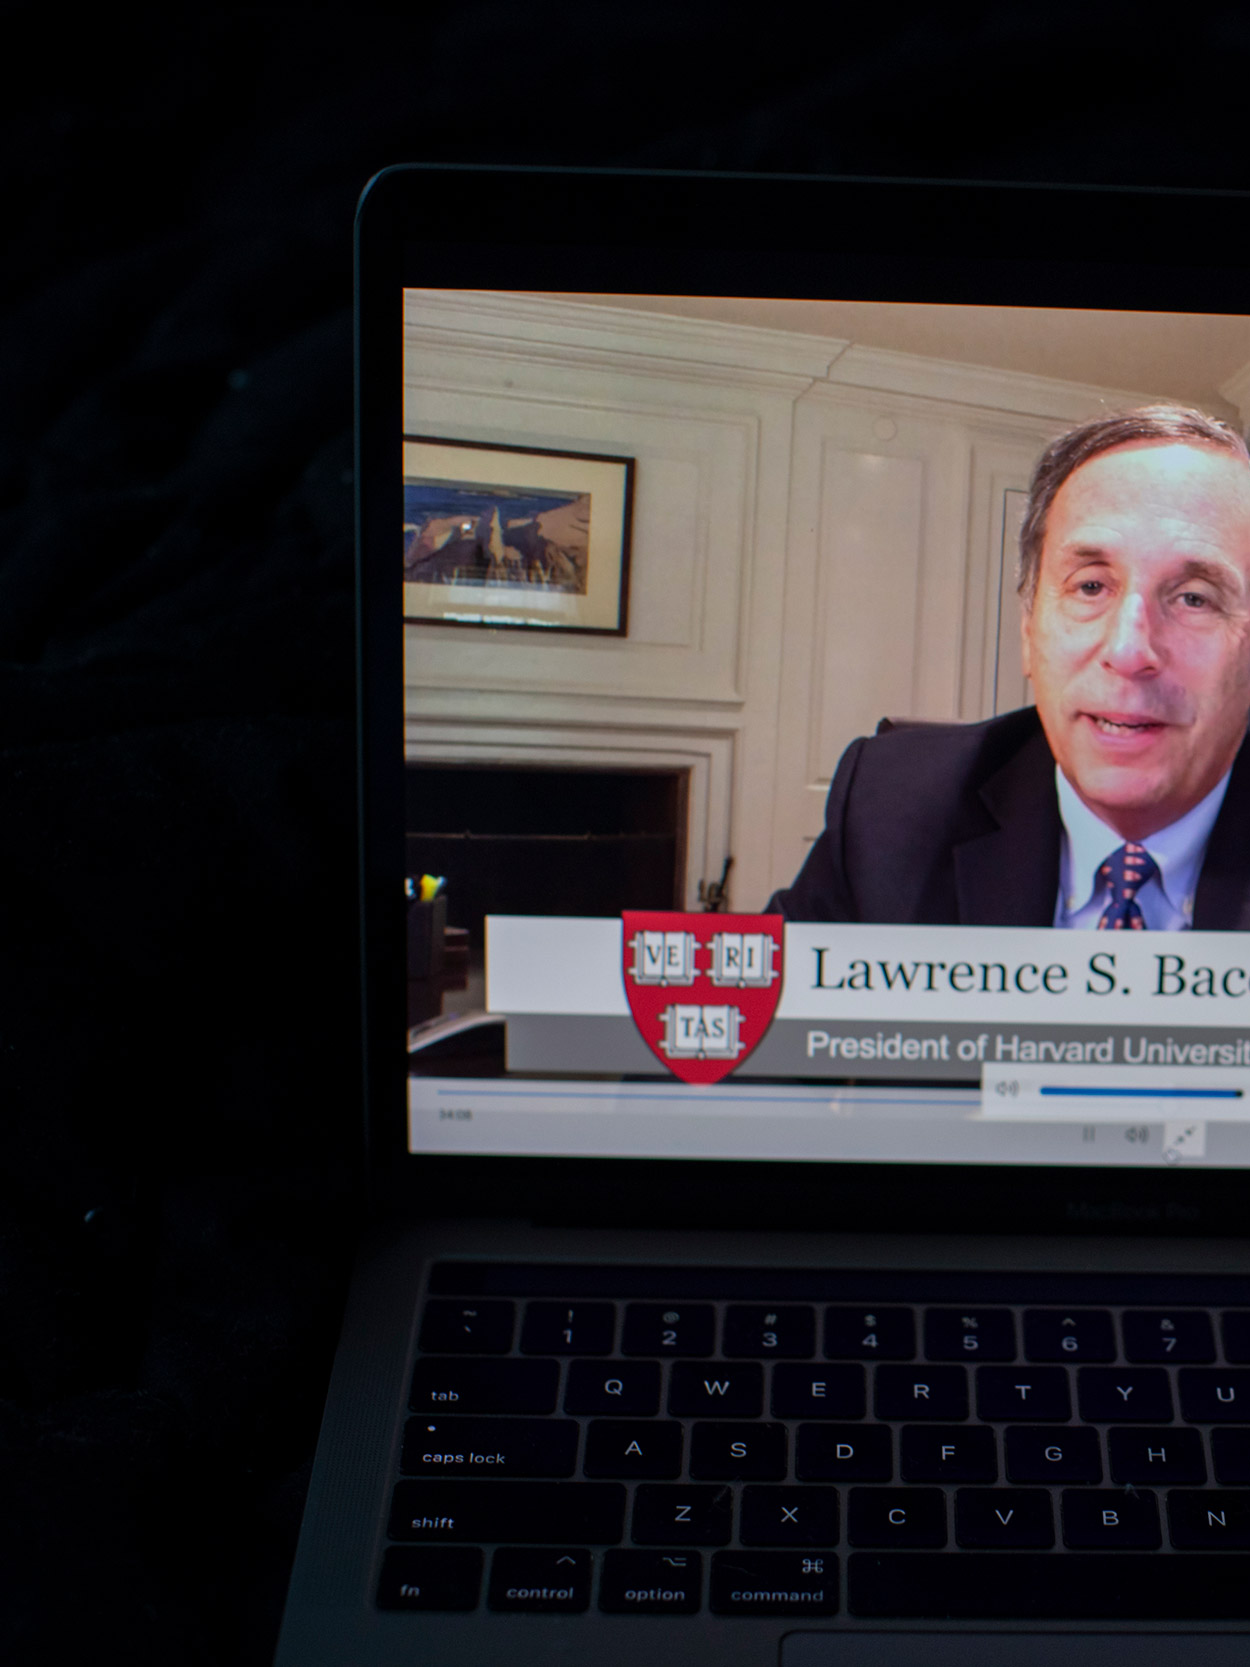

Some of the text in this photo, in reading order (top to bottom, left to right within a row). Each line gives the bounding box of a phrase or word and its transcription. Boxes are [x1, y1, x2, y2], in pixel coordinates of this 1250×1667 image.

[646, 944, 680, 967] VE
[725, 946, 755, 968] RI
[810, 947, 1068, 994] Lawrence
[1085, 953, 1131, 997] S.
[680, 1016, 726, 1039] TAS
[806, 1031, 949, 1061] President
[957, 1035, 988, 1061] of
[995, 1036, 1114, 1063] Harvard
[764, 1313, 777, 1325] #
[865, 1314, 877, 1327] $
[662, 1330, 677, 1345] 2
[762, 1332, 778, 1347] 3
[862, 1333, 878, 1348] 4
[963, 1335, 979, 1350] 5
[1061, 1336, 1079, 1352] 6
[1162, 1337, 1177, 1352] 7
[604, 1378, 624, 1396] Q
[703, 1379, 730, 1395] W
[812, 1381, 826, 1397] E
[913, 1383, 930, 1399] R
[1015, 1384, 1032, 1400] T
[1116, 1385, 1134, 1401] Y
[1216, 1387, 1235, 1402] U
[431, 1390, 460, 1401] tab
[624, 1440, 643, 1456] A
[730, 1441, 747, 1458] S
[836, 1443, 854, 1459] D
[941, 1444, 956, 1461] F
[1044, 1445, 1063, 1462] G
[1147, 1447, 1166, 1462] H
[422, 1451, 505, 1465] caps lock
[674, 1505, 692, 1522] Z
[781, 1506, 799, 1523] X
[888, 1508, 906, 1525] C
[995, 1509, 1014, 1525] V
[1102, 1509, 1119, 1526] B
[1207, 1510, 1226, 1526] N
[412, 1516, 455, 1529] shift
[400, 1583, 421, 1596] fn
[506, 1587, 574, 1599] control
[624, 1587, 686, 1601] option
[731, 1590, 824, 1601] command
